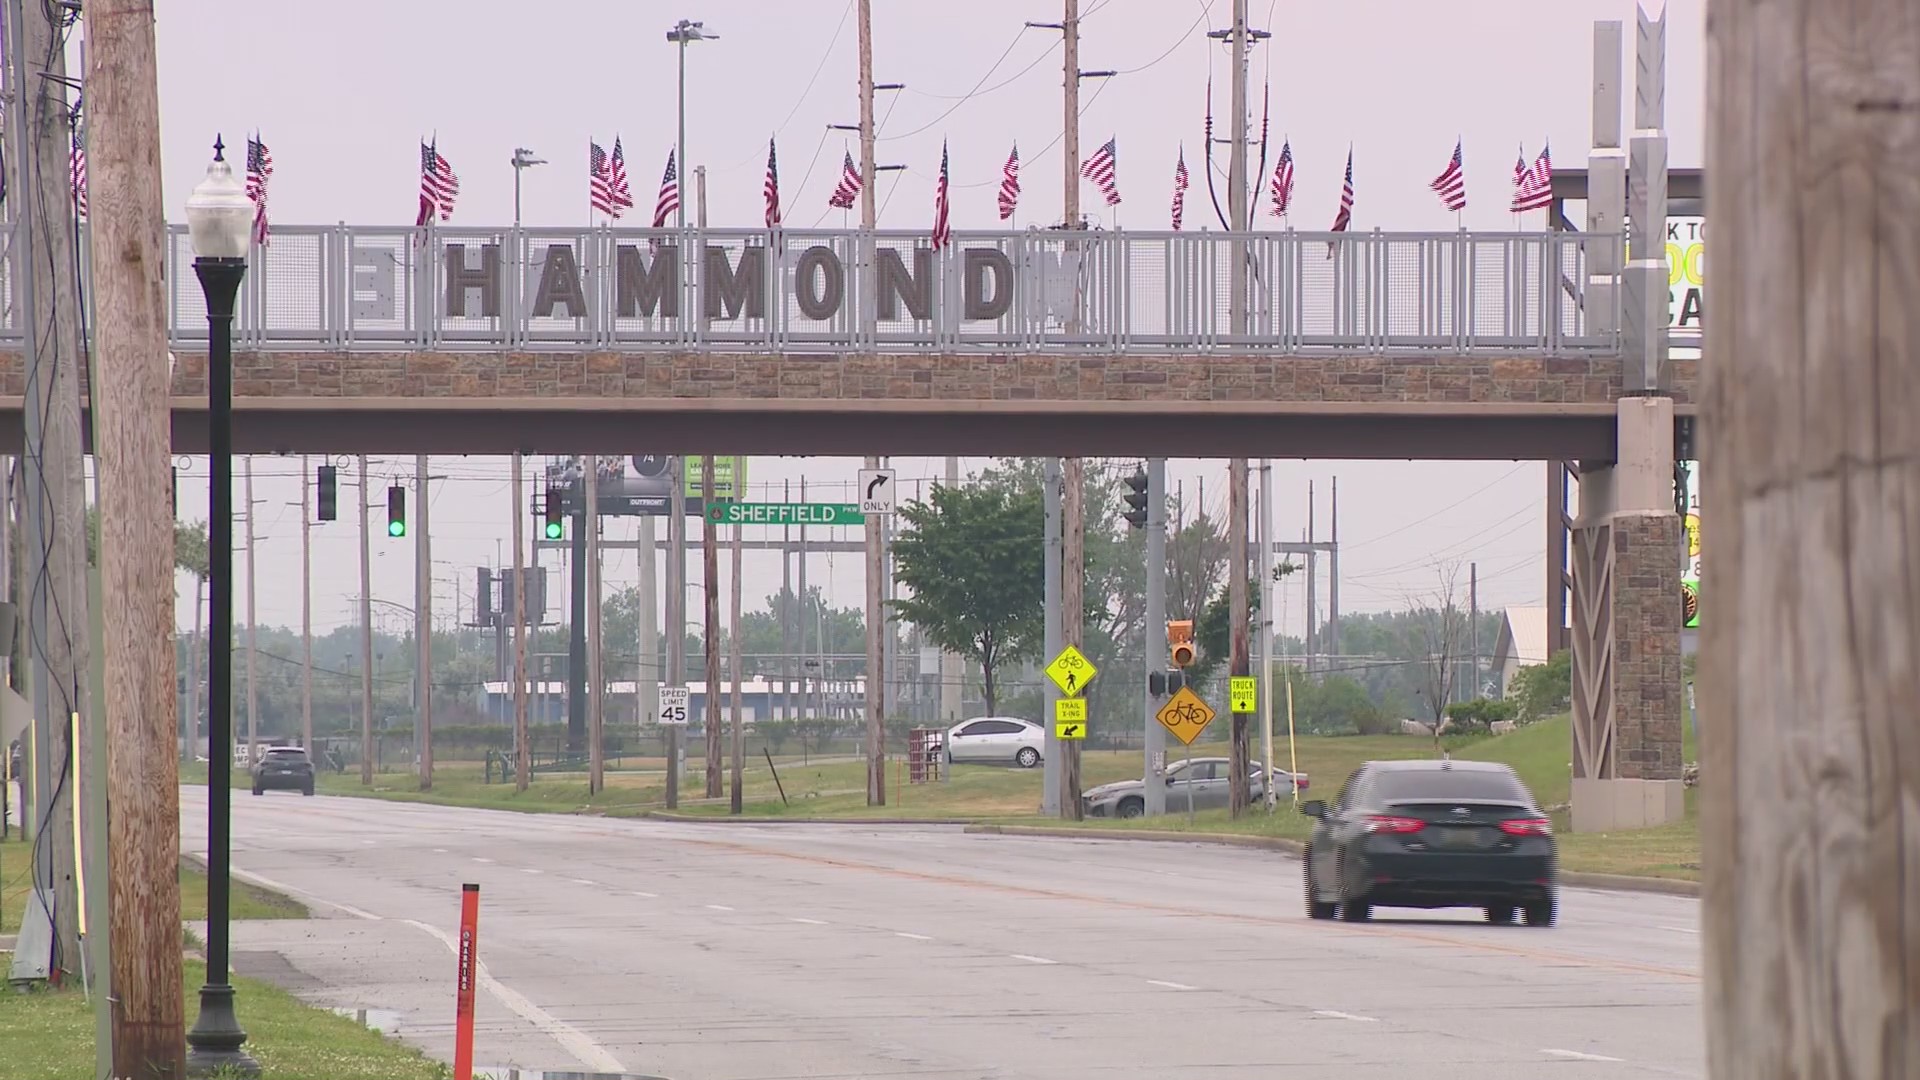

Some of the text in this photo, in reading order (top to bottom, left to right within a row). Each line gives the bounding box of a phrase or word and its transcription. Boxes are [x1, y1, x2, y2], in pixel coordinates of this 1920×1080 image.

[446, 243, 1014, 320] HAMMOND
[864, 502, 889, 511] ONLY
[729, 506, 835, 521] SHEFFIELD
[1232, 681, 1253, 689] TRUCK
[1232, 691, 1253, 699] ROUTE
[661, 707, 685, 720] 45
